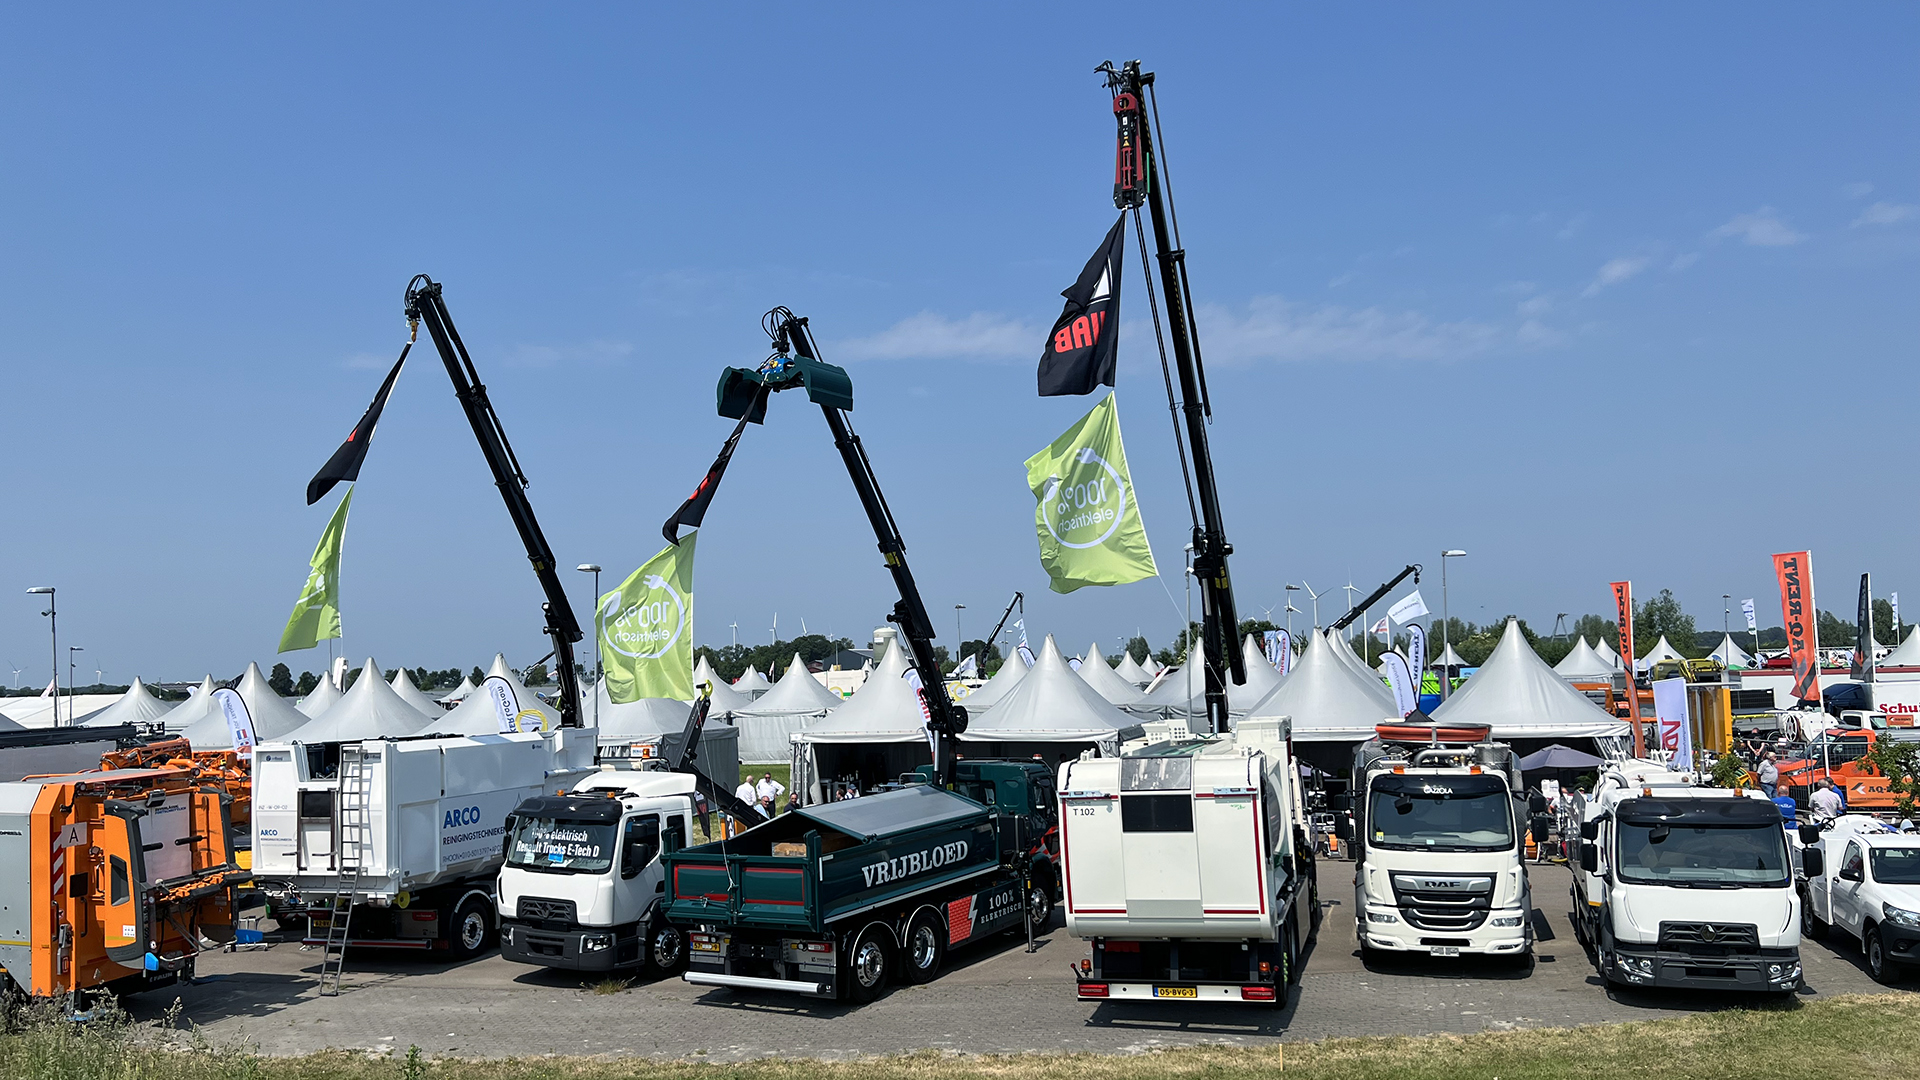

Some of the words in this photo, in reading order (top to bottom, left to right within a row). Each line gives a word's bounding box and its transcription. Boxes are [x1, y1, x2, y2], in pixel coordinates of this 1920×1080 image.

[1879, 702, 1920, 713] Schu
[443, 806, 480, 829] ARCO
[1073, 808, 1079, 816] T
[1080, 807, 1095, 816] 102
[69, 827, 79, 843] A
[550, 828, 588, 842] elektrisch
[516, 840, 541, 853] Renault
[542, 842, 566, 854] Trucks
[567, 844, 591, 857] E-Tech
[592, 845, 600, 857] D
[862, 840, 968, 887] VRIJBLOED
[989, 889, 1014, 909] 100%
[981, 902, 1022, 924] ELEKTRISCH
